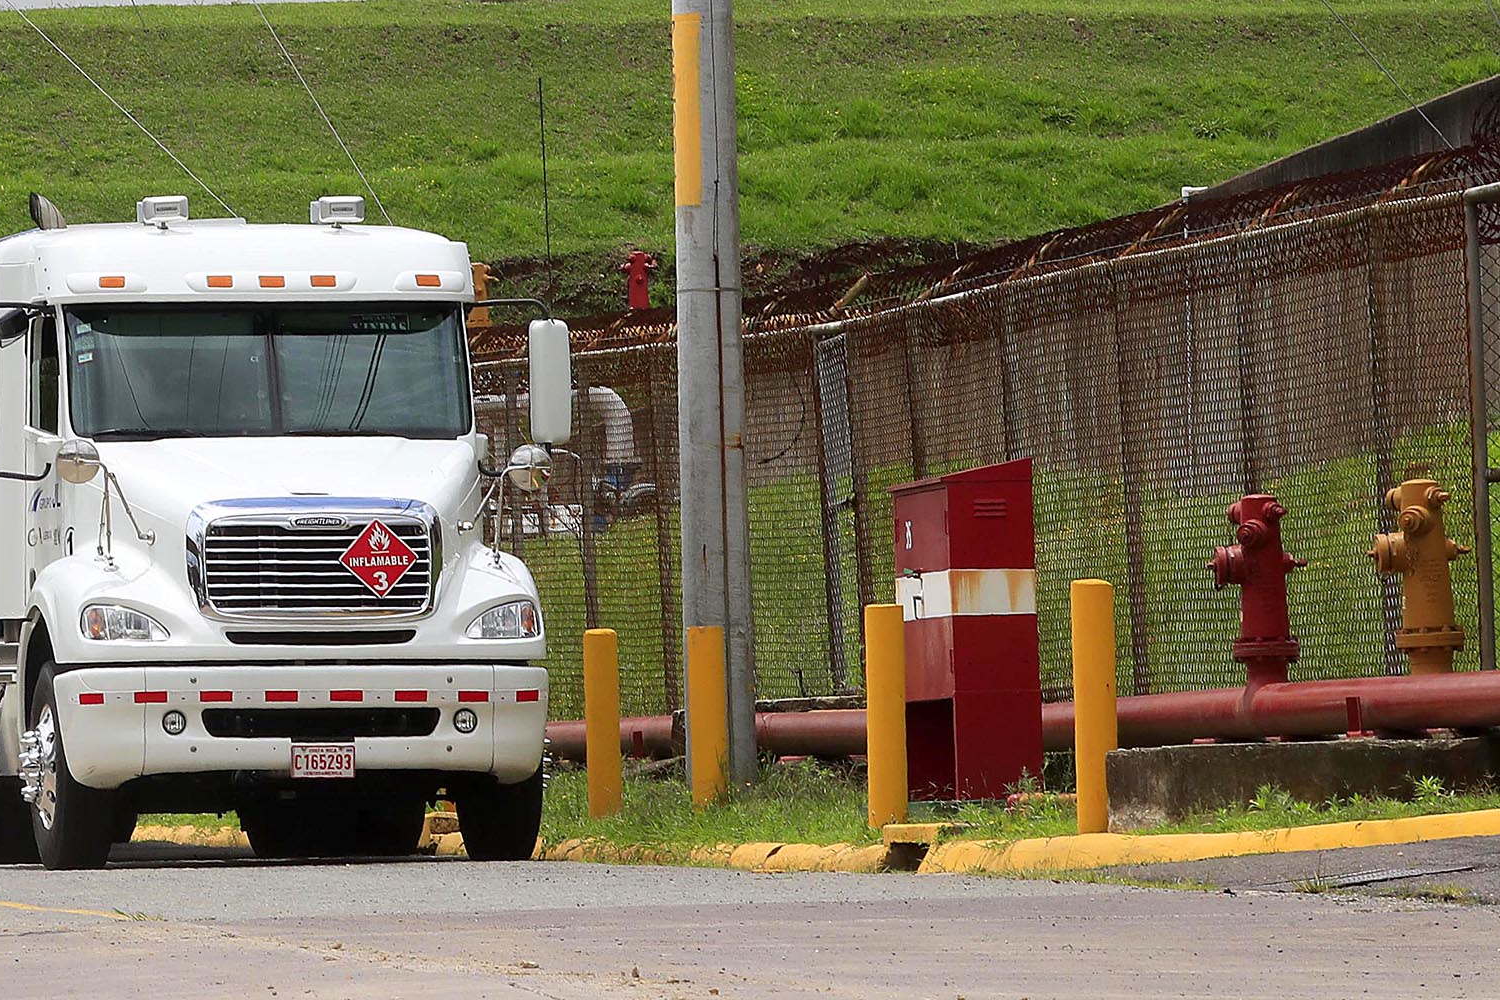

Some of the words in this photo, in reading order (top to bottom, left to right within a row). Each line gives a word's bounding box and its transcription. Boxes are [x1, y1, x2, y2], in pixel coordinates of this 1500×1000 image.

[296, 517, 340, 525] FREIGHTLINER
[349, 555, 409, 567] INFLAMABLE
[372, 571, 389, 591] 3
[295, 754, 352, 770] C165293
